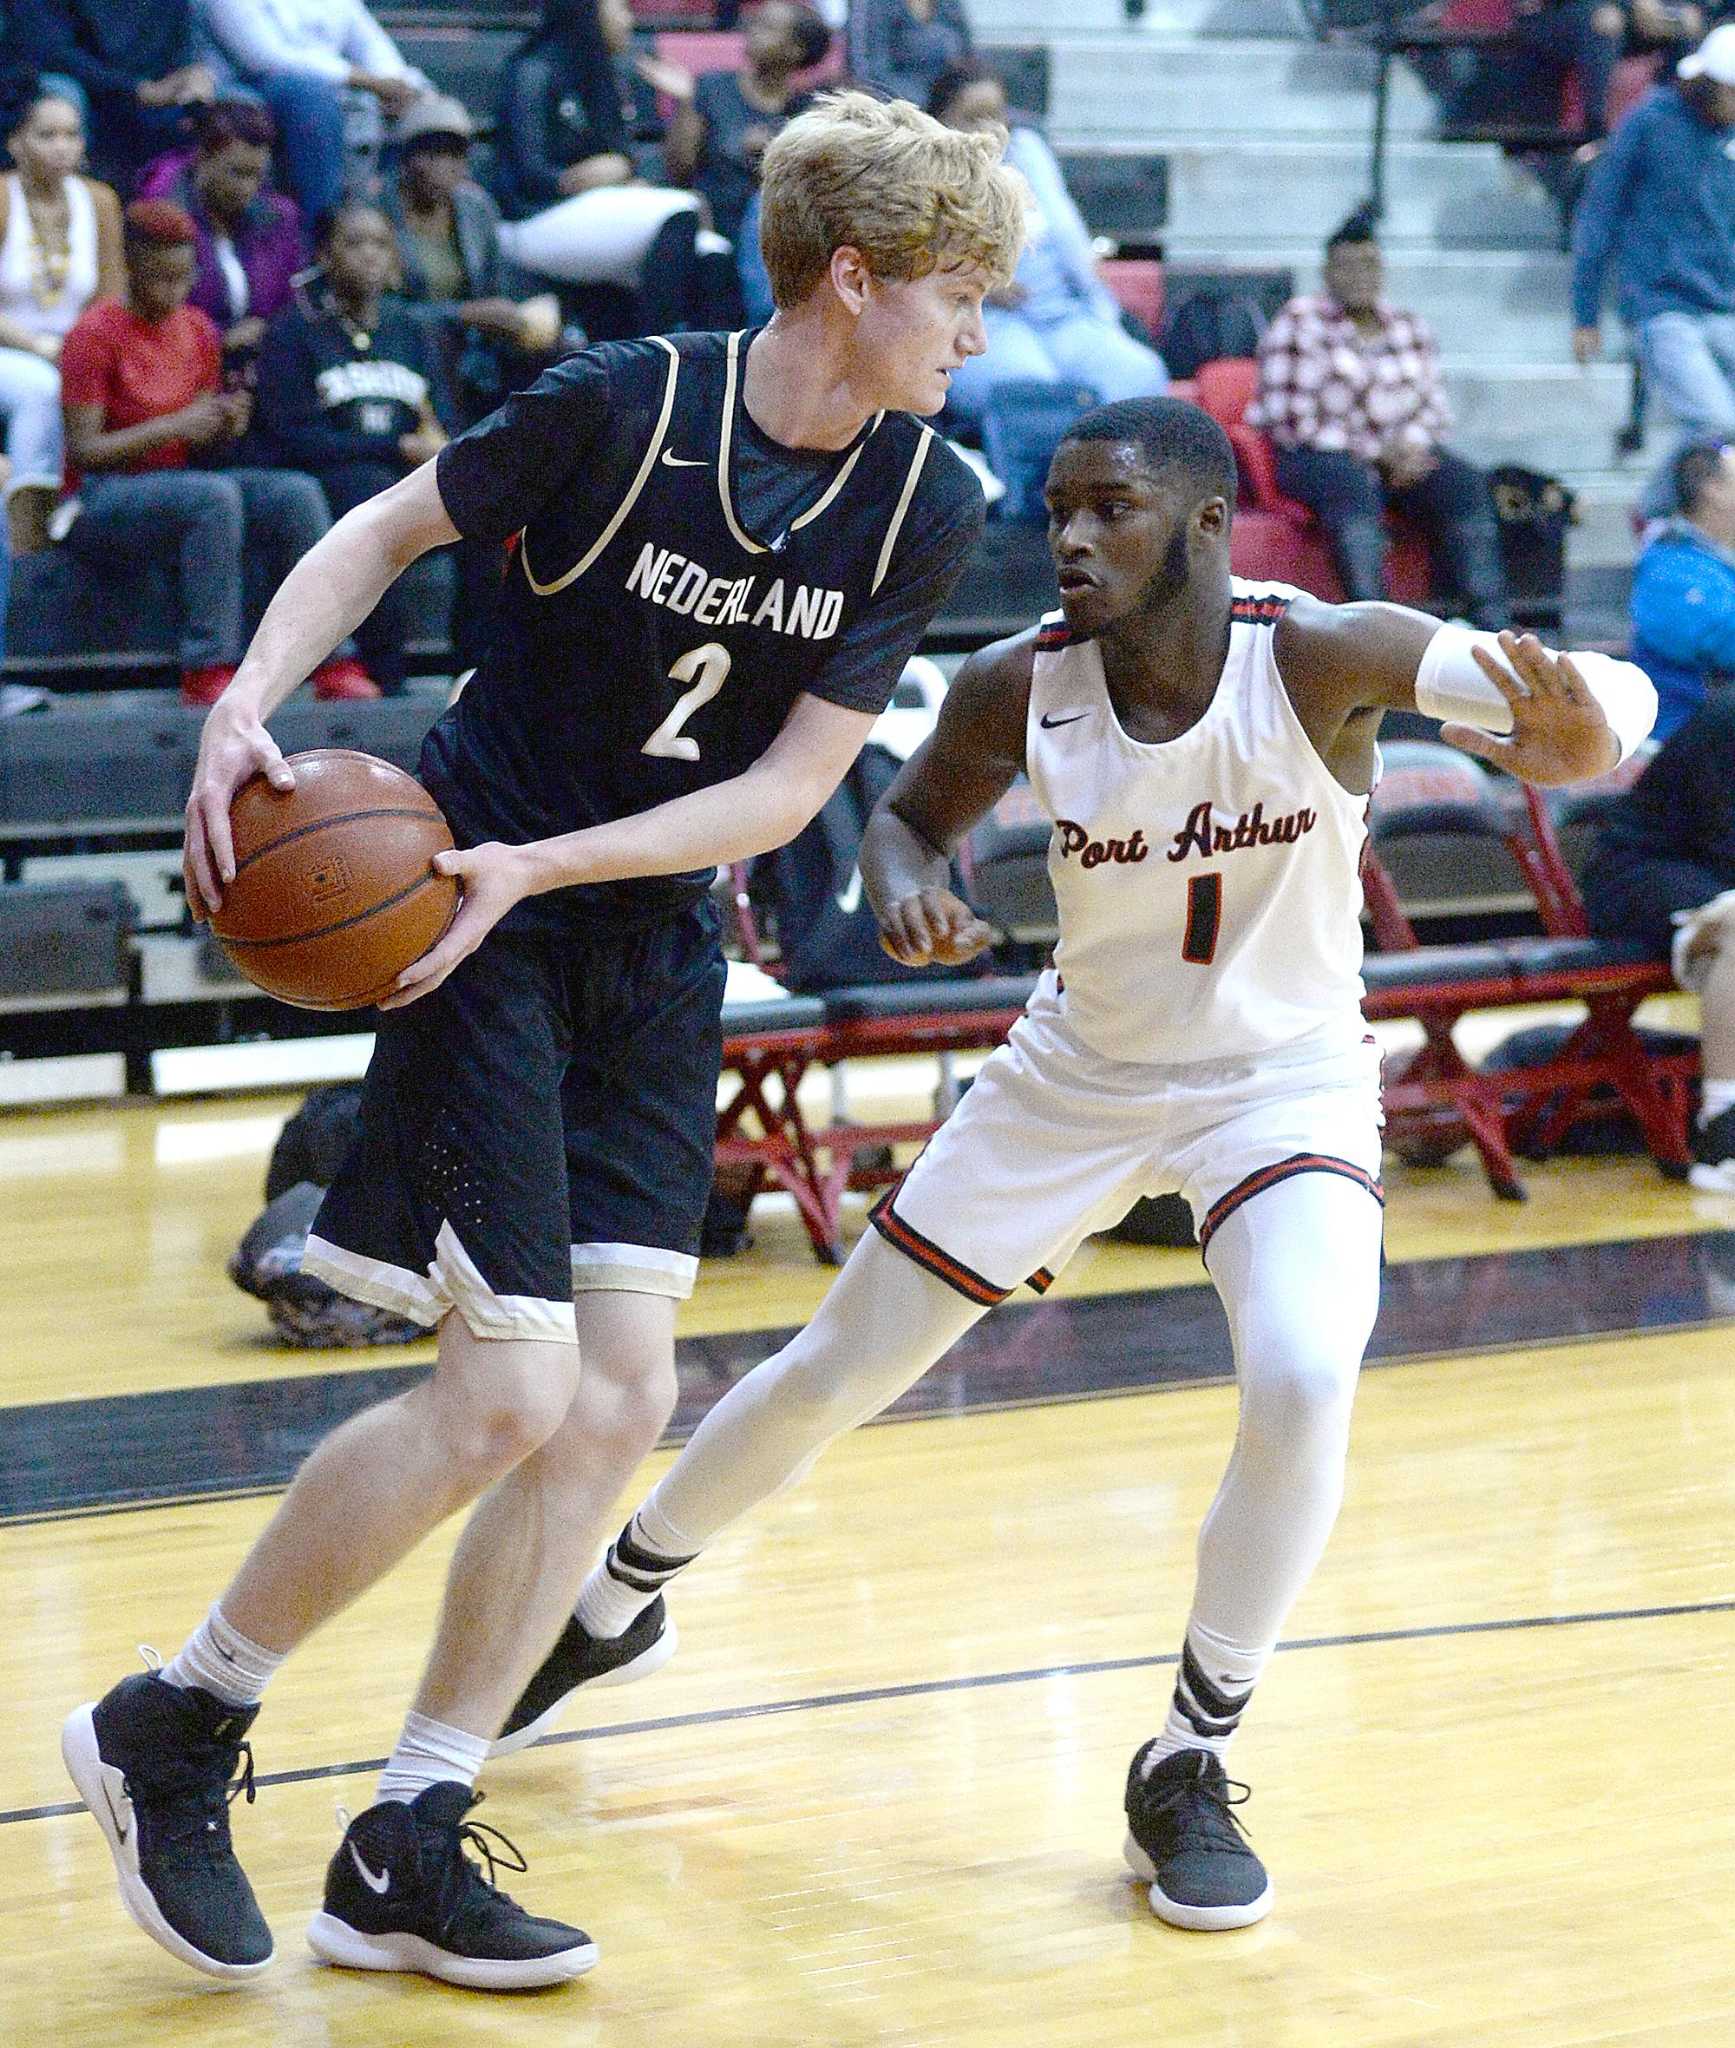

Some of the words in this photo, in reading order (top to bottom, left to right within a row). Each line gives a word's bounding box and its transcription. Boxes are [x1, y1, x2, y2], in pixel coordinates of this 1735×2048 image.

[625, 542, 844, 640] NEDERLAND
[641, 643, 731, 761] 2
[1055, 819, 1149, 869] Port
[1167, 801, 1316, 862] Arthur
[1181, 872, 1222, 965] 1
